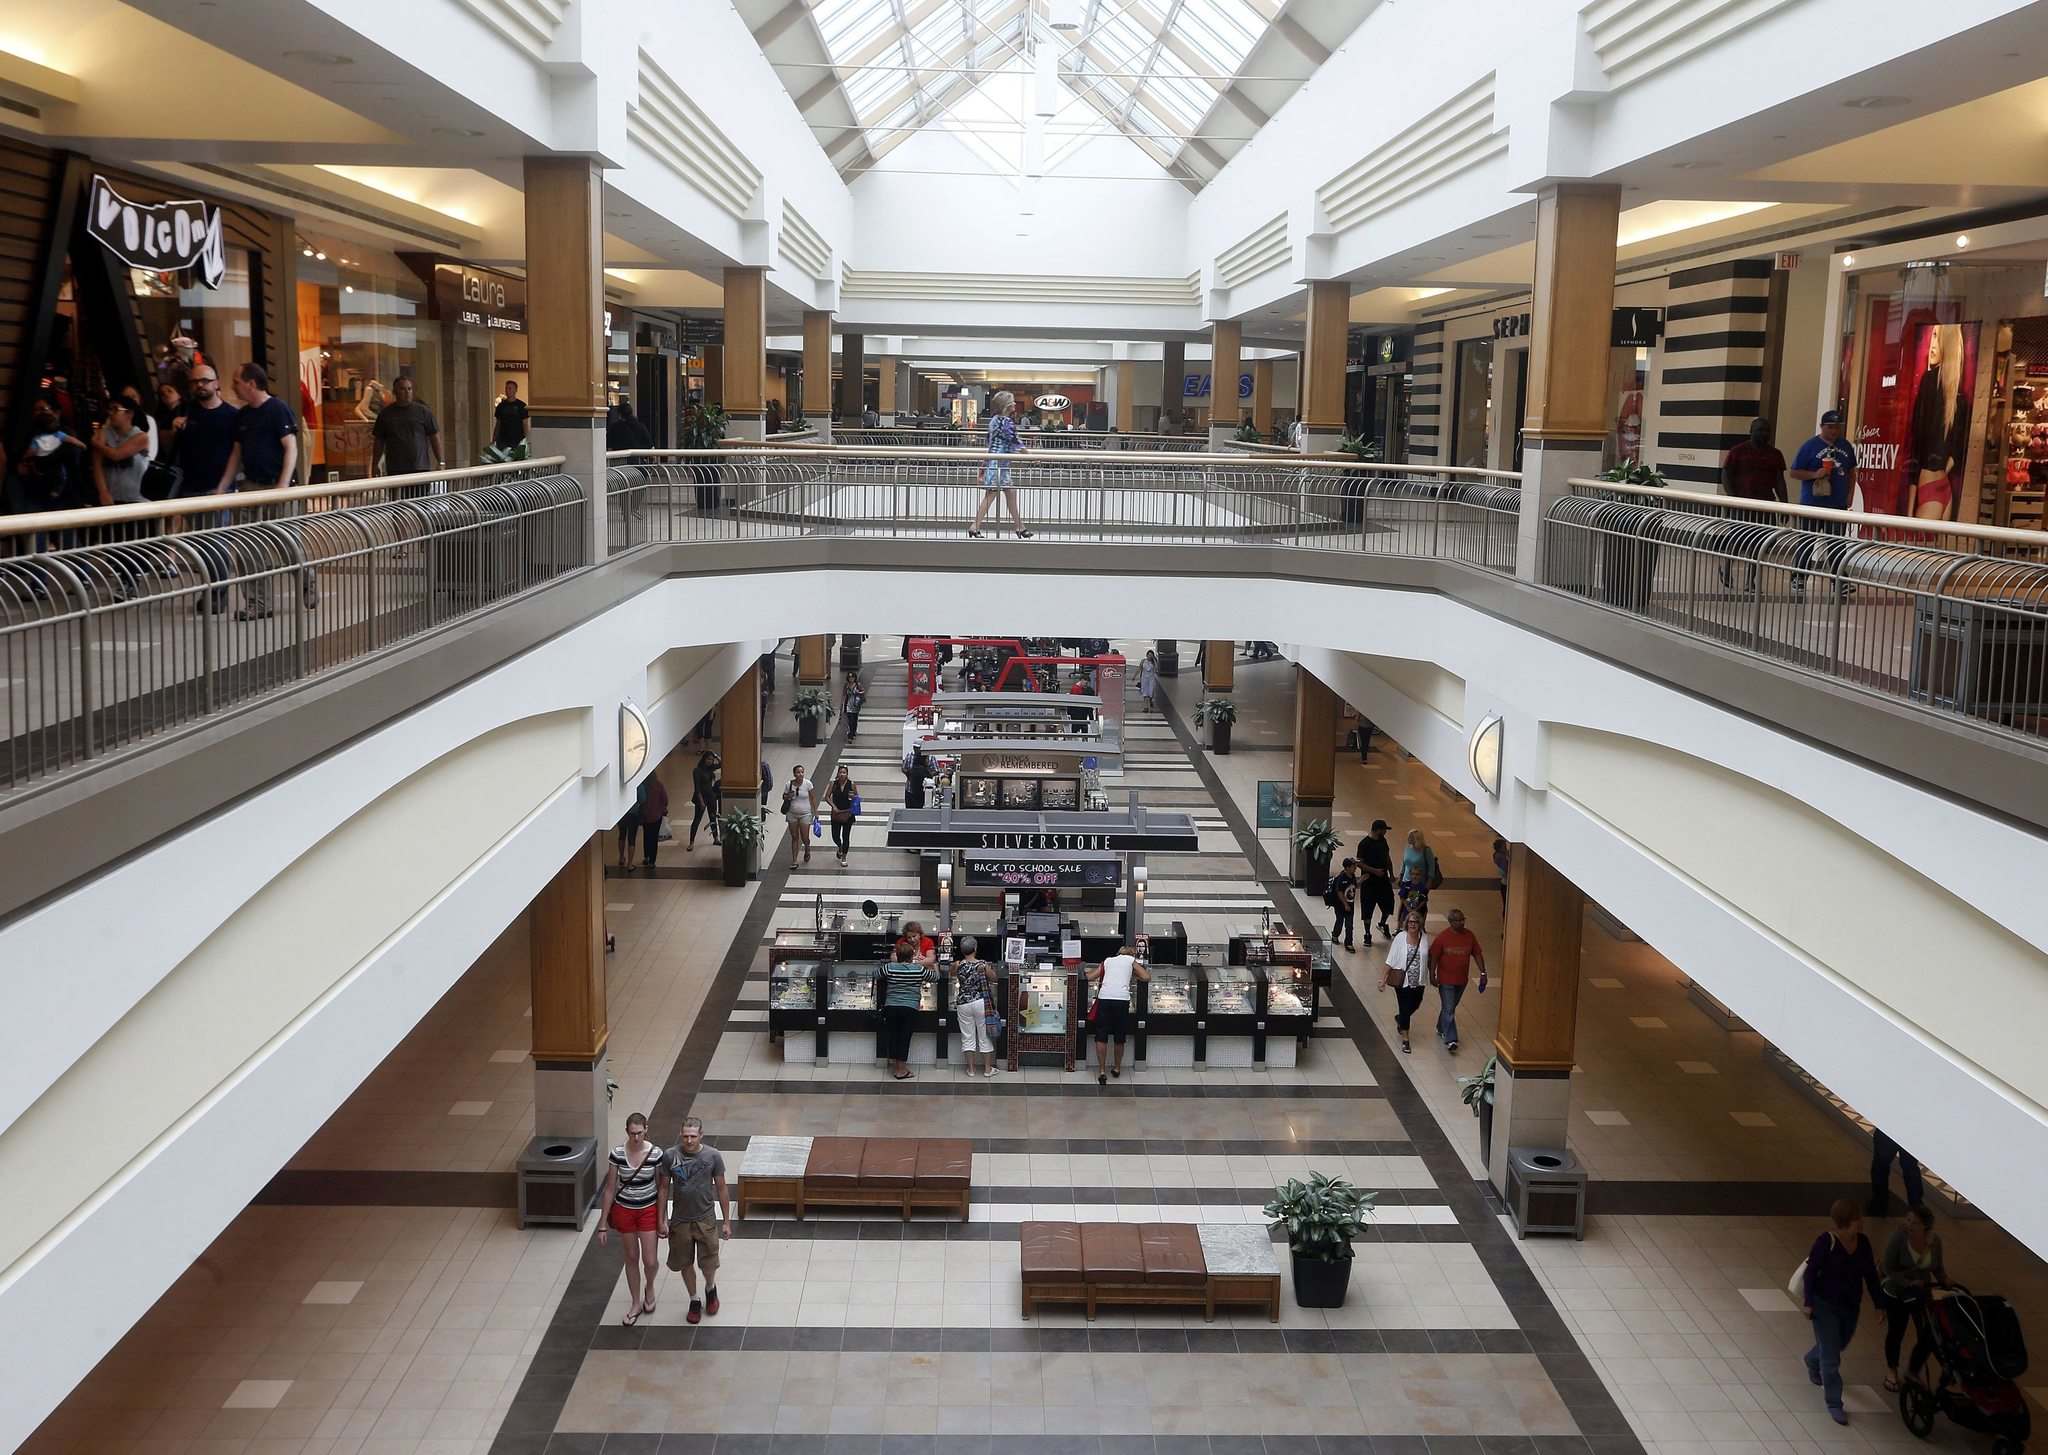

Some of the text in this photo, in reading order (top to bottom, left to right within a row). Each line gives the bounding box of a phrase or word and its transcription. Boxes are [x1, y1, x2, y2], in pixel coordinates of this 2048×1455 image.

[1781, 255, 1798, 268] EXIT
[1493, 313, 1531, 340] SEPH
[981, 834, 1110, 850] SILVERSTONE
[974, 863, 1082, 873] BACK TO SCHOOL SALE
